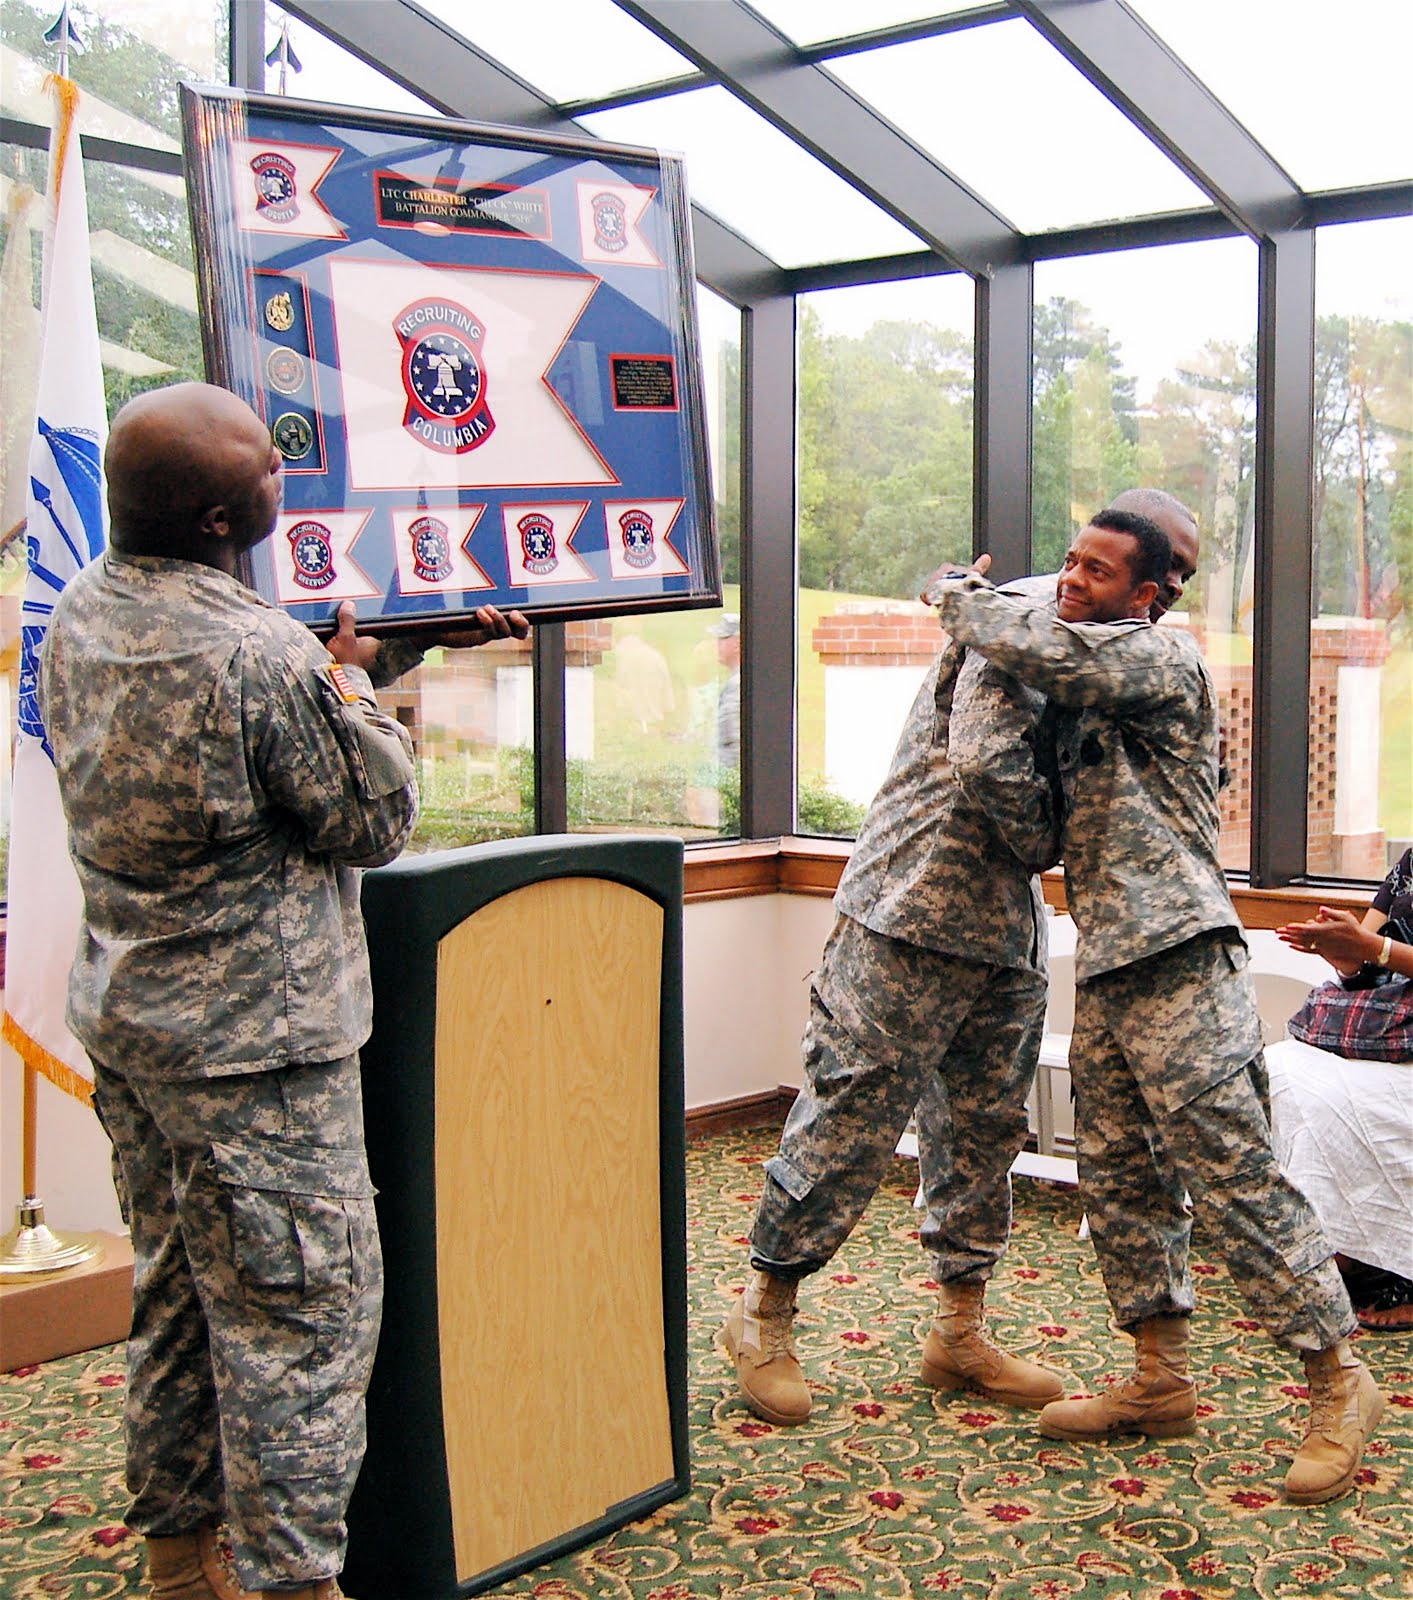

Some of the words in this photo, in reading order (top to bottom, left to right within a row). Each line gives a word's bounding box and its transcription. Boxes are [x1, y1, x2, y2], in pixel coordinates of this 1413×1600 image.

[253, 155, 294, 172] RECRUITING
[381, 187, 401, 198] LTC
[402, 190, 468, 206] CHARLESTER
[513, 200, 545, 214] WHITE
[395, 202, 449, 216] BATTALION
[450, 207, 511, 222] COMMANDER
[398, 306, 482, 340] RECRUITING
[413, 416, 488, 448] COLUMBIA
[410, 520, 447, 535] RECRUITING
[520, 516, 552, 530] RECRUITING
[621, 512, 652, 526] RECRUITING
[289, 523, 329, 540] RECRUITING
